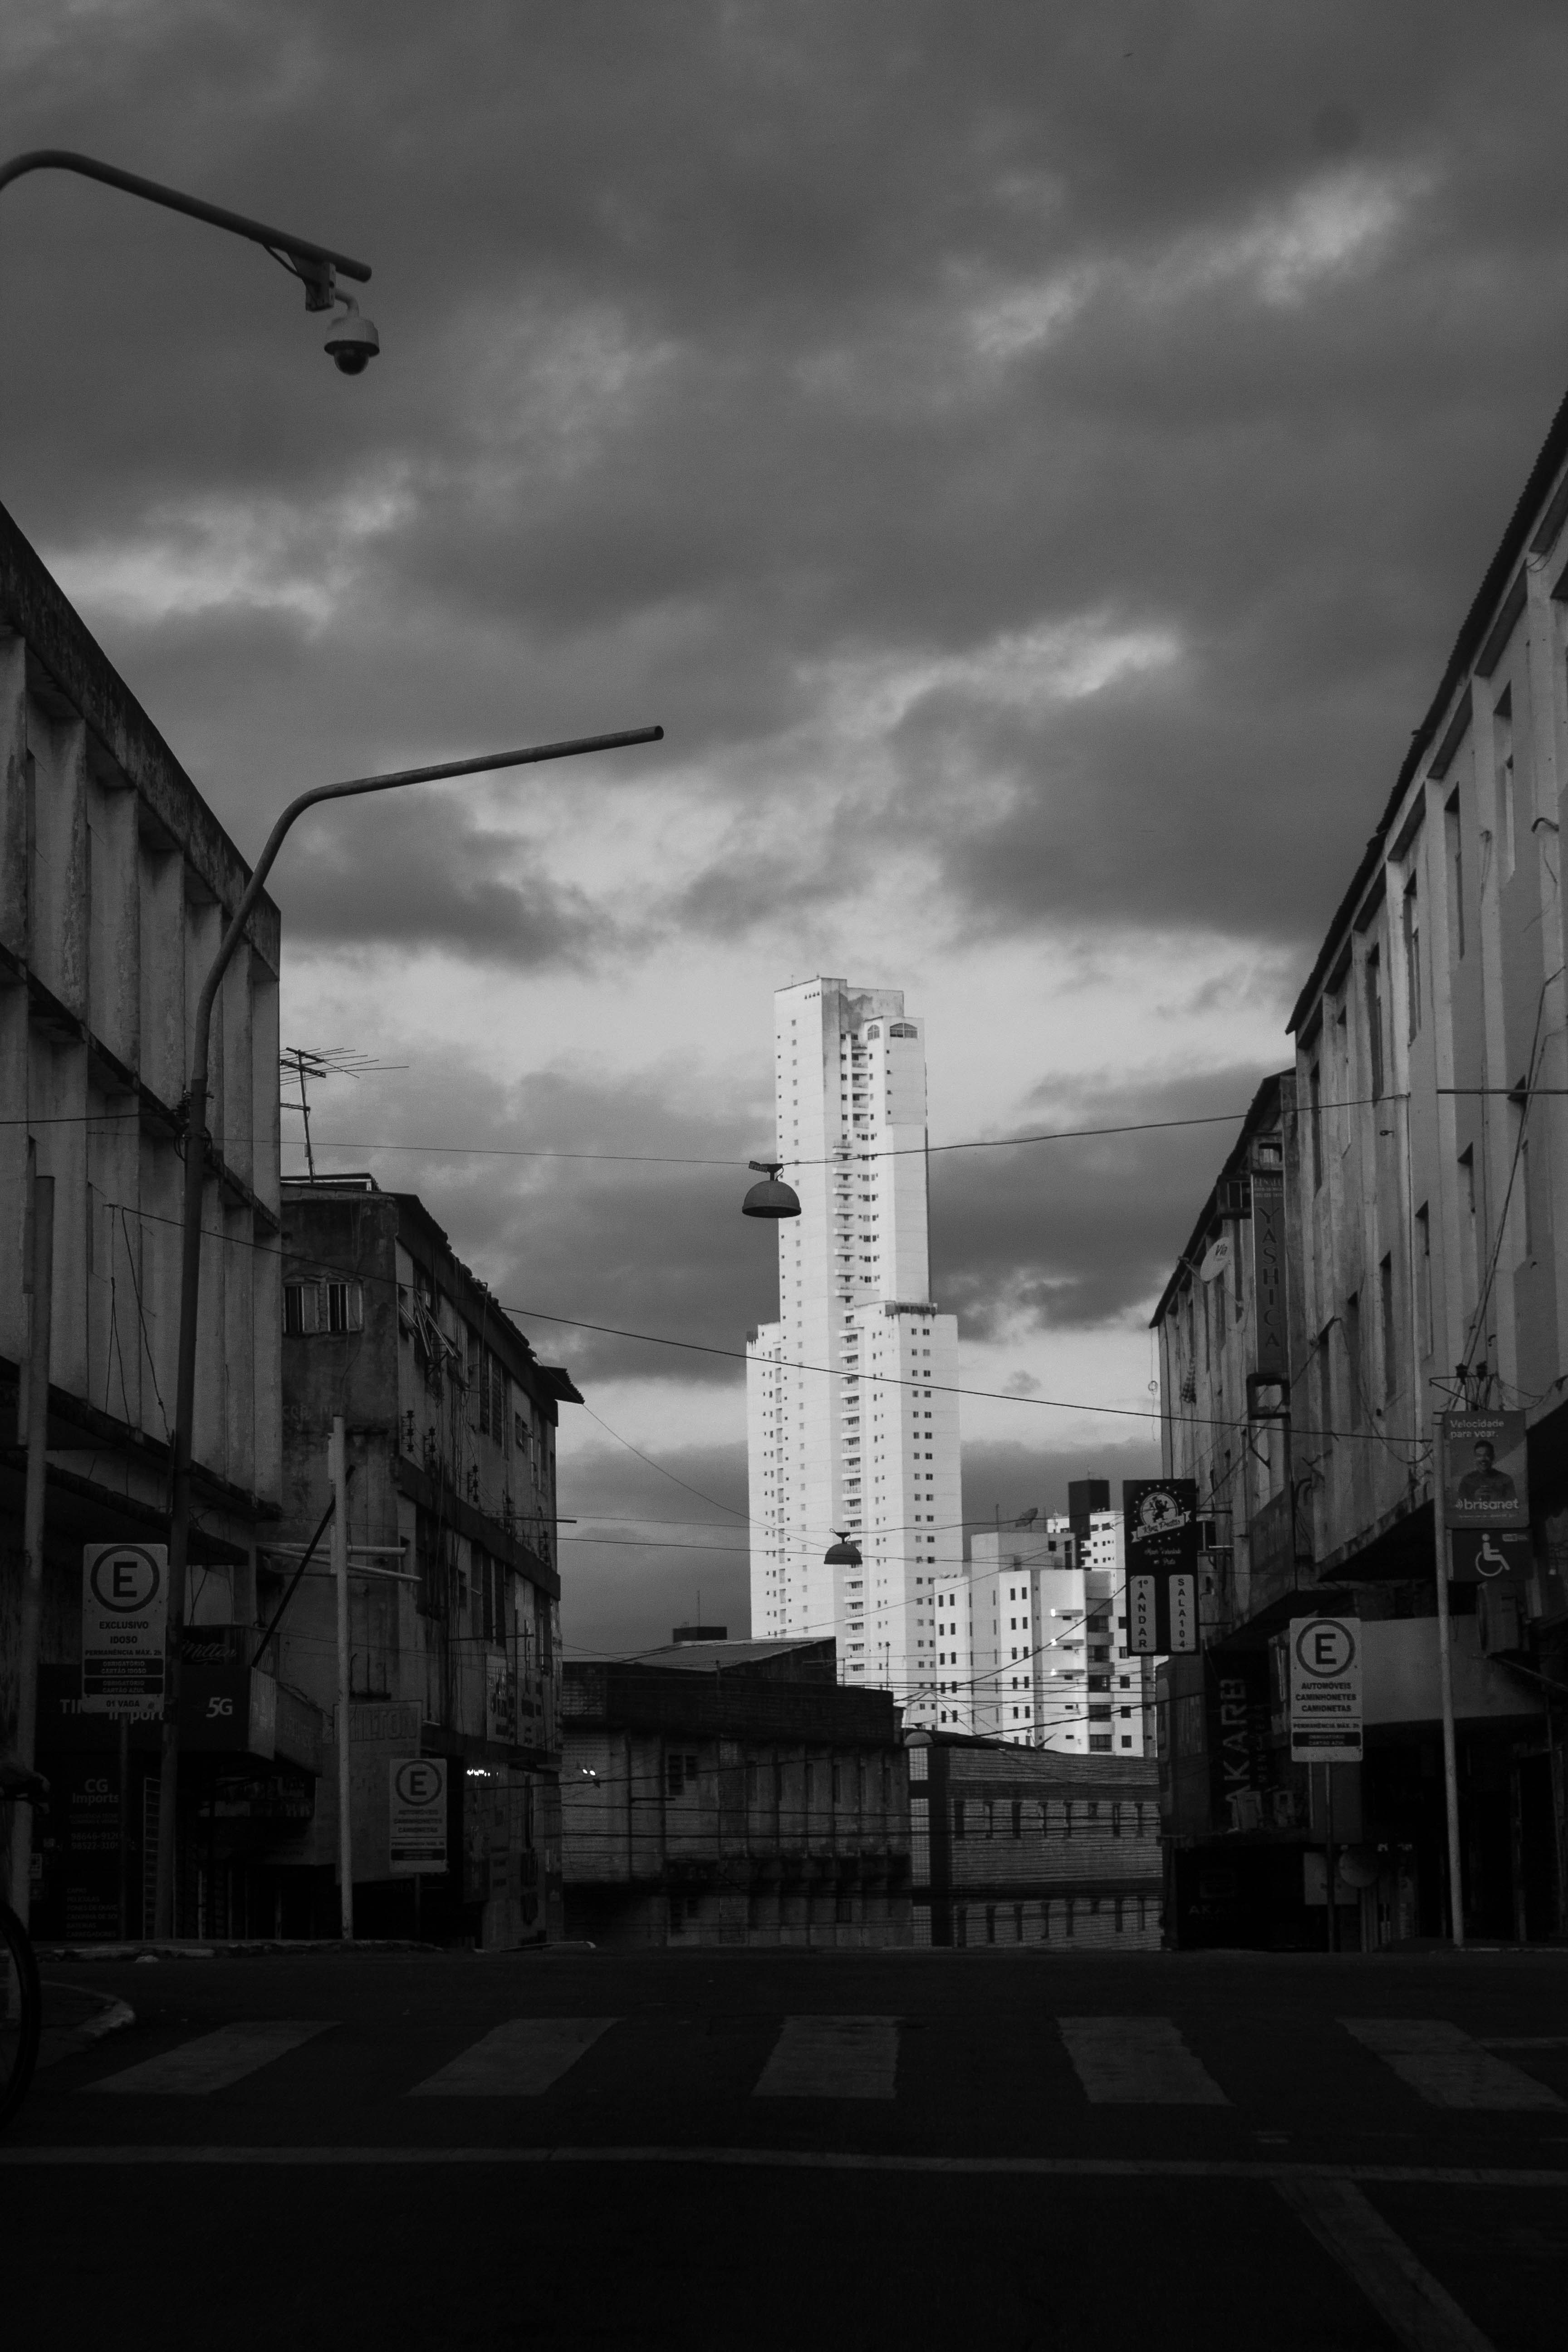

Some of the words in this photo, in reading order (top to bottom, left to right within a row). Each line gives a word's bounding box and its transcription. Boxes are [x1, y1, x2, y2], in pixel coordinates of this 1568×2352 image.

[1258, 1207, 1282, 1347] YASHICA
[1450, 1419, 1504, 1428] Velocidade
[1450, 1431, 1472, 1440] para
[1464, 1498, 1519, 1510] brisanet
[113, 1561, 137, 1597] E
[99, 1621, 149, 1629] EXCLUSIVO
[1137, 1592, 1147, 1648] ANDAR
[1315, 1633, 1337, 1665] E
[1301, 1681, 1352, 1690] AUTOMÓVEIS
[60, 1699, 84, 1714] TI
[207, 1697, 233, 1718] 5G
[84, 1778, 109, 1793] CG
[411, 1771, 427, 1795] E
[73, 1793, 120, 1807] Imports
